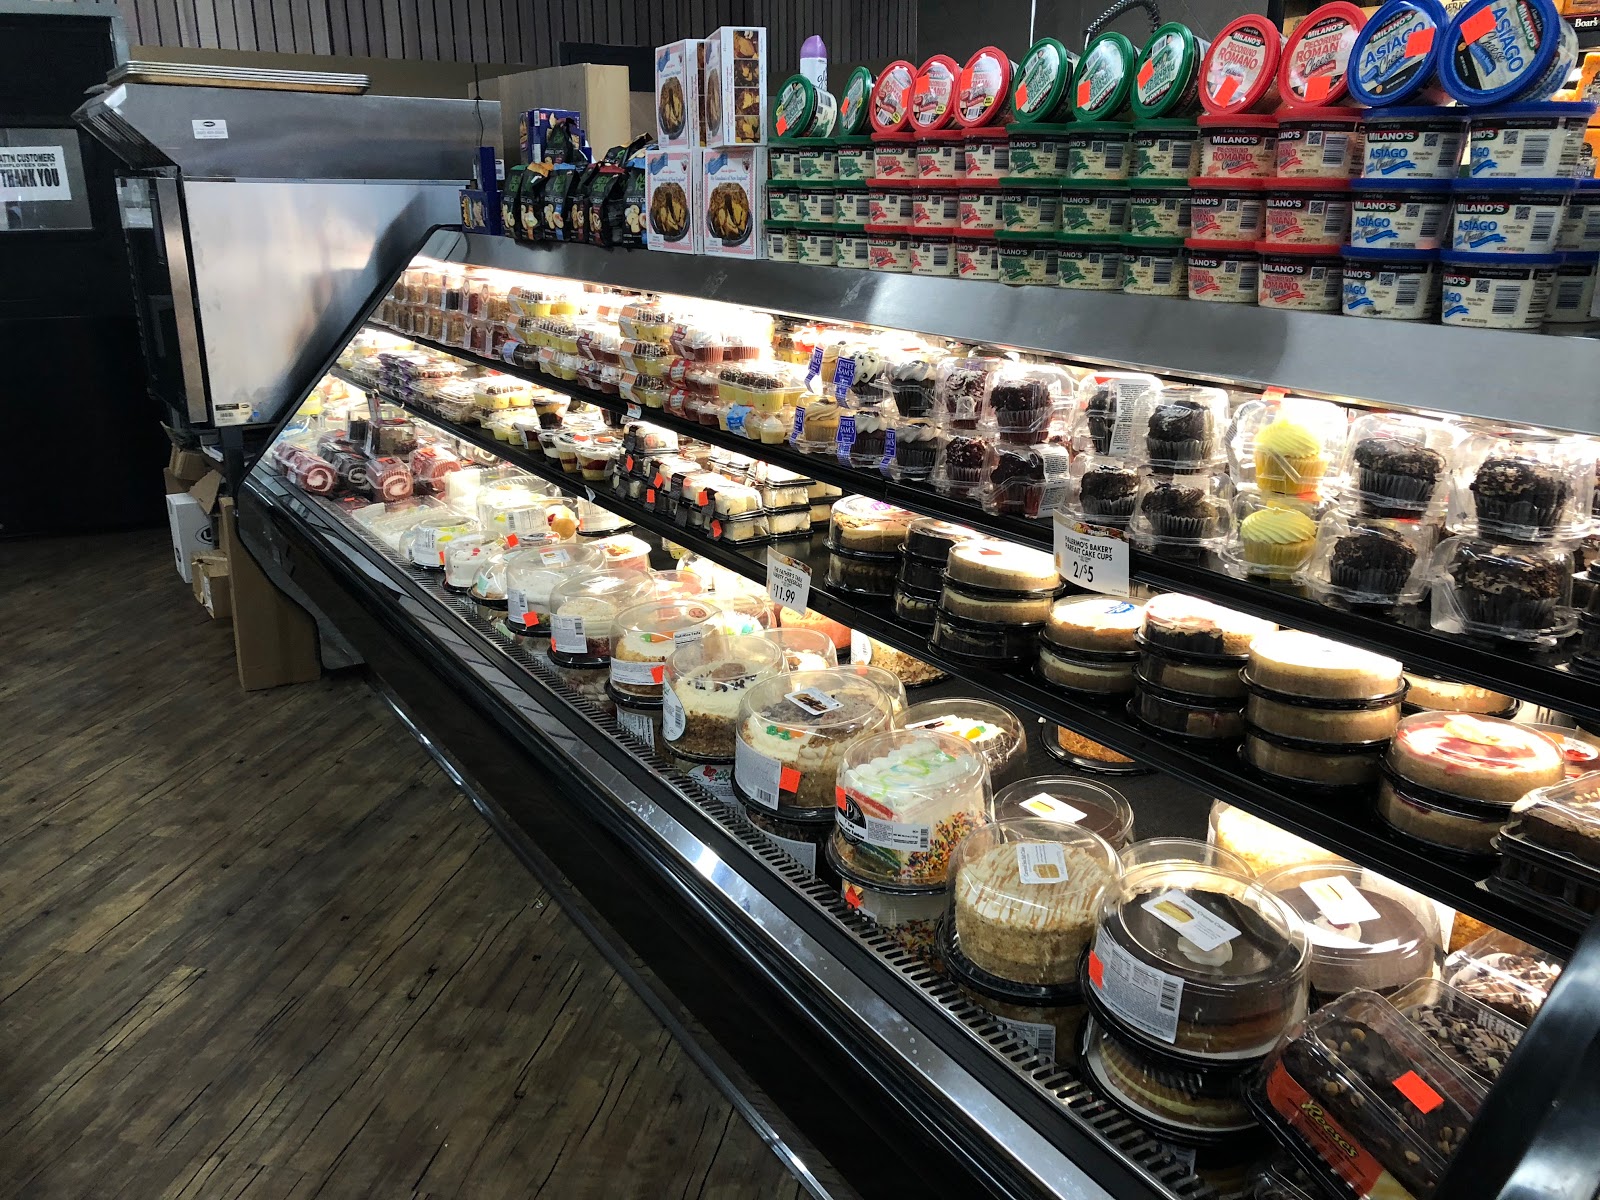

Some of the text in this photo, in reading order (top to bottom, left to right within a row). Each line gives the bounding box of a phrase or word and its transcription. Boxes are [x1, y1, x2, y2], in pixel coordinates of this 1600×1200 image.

[1308, 22, 1344, 39] MILANO'S
[1373, 13, 1413, 42] MILANO'S
[1518, 4, 1537, 48] MILANO'S
[1233, 32, 1262, 46] MILANO'S
[1304, 33, 1342, 49] PECORINO
[1365, 21, 1425, 68] ASIAGO
[1481, 31, 1506, 62] Cheese
[1493, 7, 1524, 73] ASIAGO
[1218, 47, 1259, 70] ROMANO
[1212, 135, 1258, 144] MILANO'S
[1369, 132, 1414, 141] MILANO'S
[16, 153, 56, 163] CUSTOMERS
[1212, 151, 1253, 161] ROMANO
[1370, 147, 1408, 159] ASIAGO
[0, 168, 60, 188] THANK YOU
[1355, 216, 1390, 228] ASIAGO
[1458, 219, 1497, 231] ASIAGO
[1343, 269, 1372, 278] LANO'S
[838, 367, 854, 377] SAM'S
[839, 360, 855, 369] SWEET
[840, 418, 855, 427] SWEET
[840, 426, 855, 434] SAM'S
[1064, 535, 1113, 554] PALERMO'S BAKERY
[1065, 543, 1081, 555] PARFAIT
[1081, 549, 1096, 559] CAKE
[1096, 552, 1113, 561] CUPS
[1073, 561, 1094, 583] 2/$5
[773, 583, 796, 604] $11.99
[1301, 1103, 1358, 1158] Reese's
